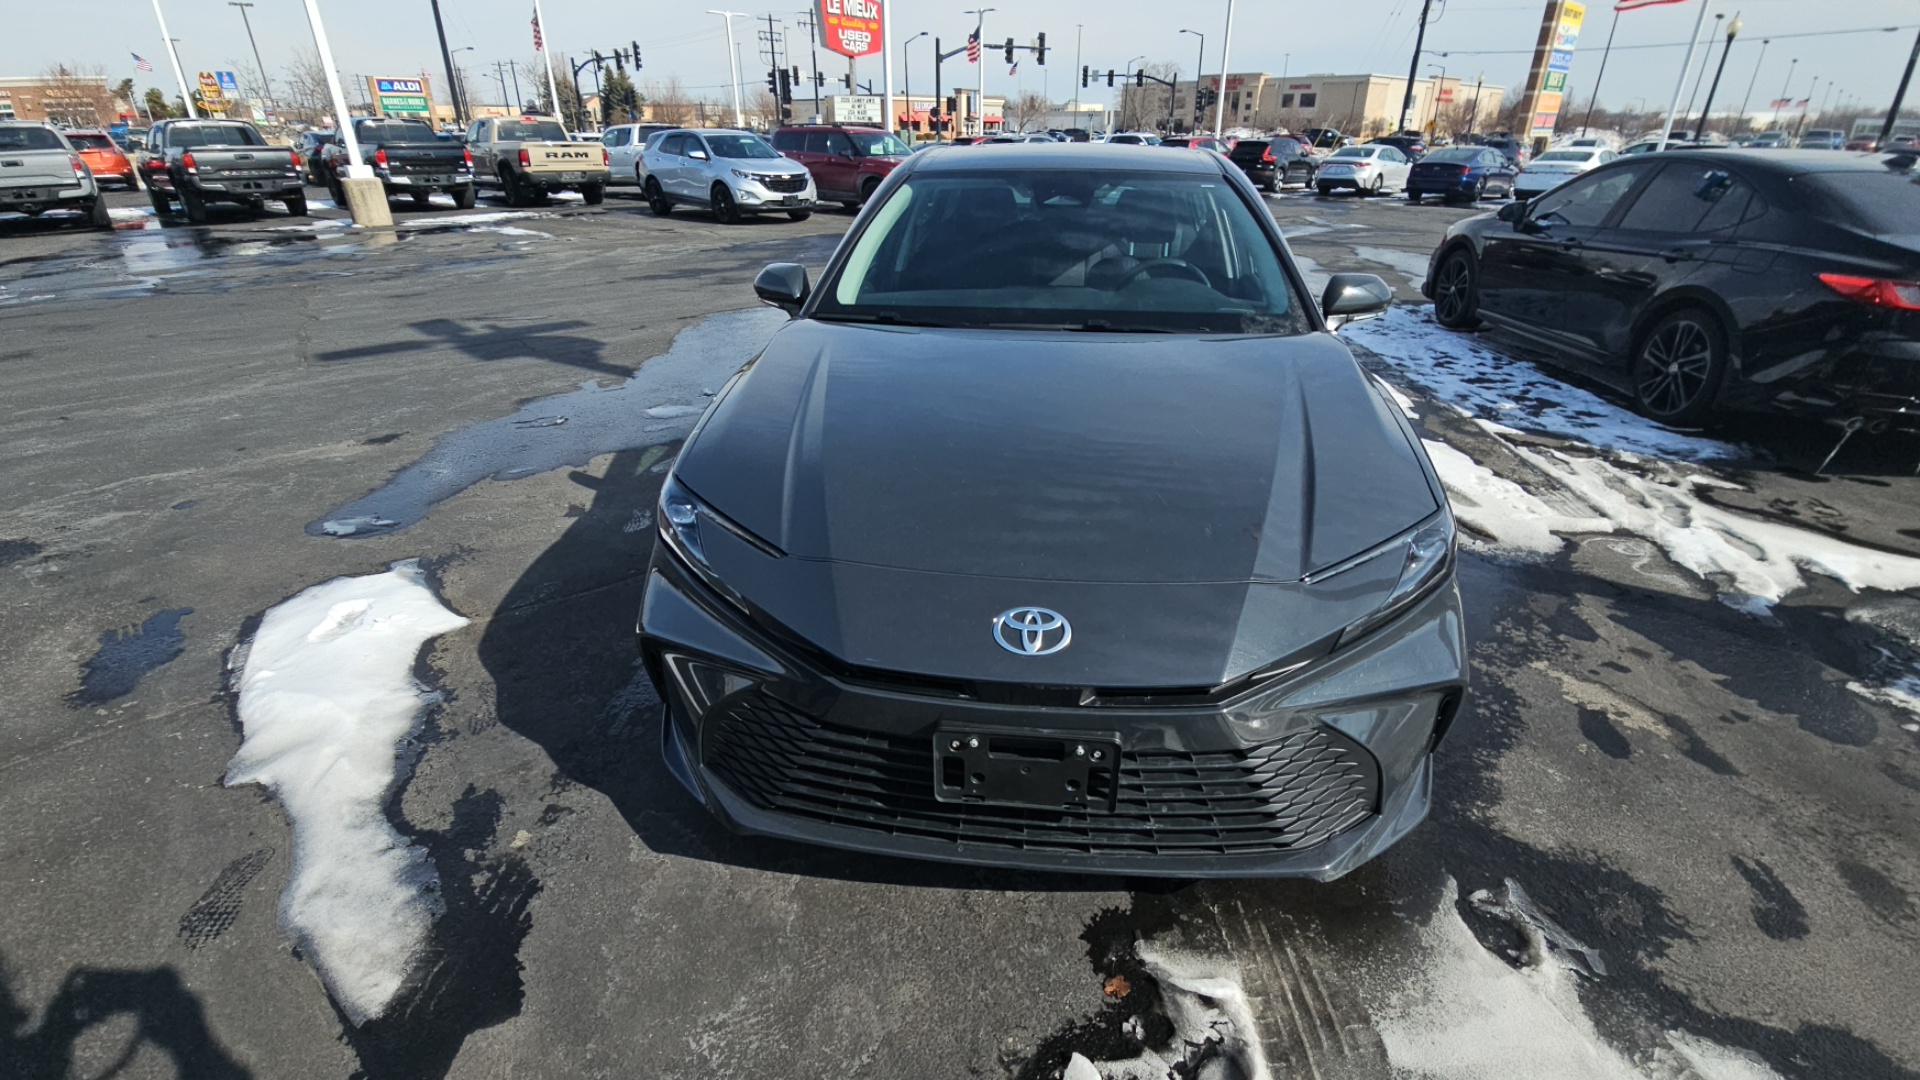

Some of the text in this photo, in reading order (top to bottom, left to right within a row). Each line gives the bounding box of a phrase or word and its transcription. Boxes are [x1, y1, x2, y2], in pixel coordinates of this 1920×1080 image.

[827, 0, 879, 20] LE MIEUX
[838, 28, 872, 43] USED
[842, 39, 869, 54] CARS
[393, 81, 421, 91] ALDI
